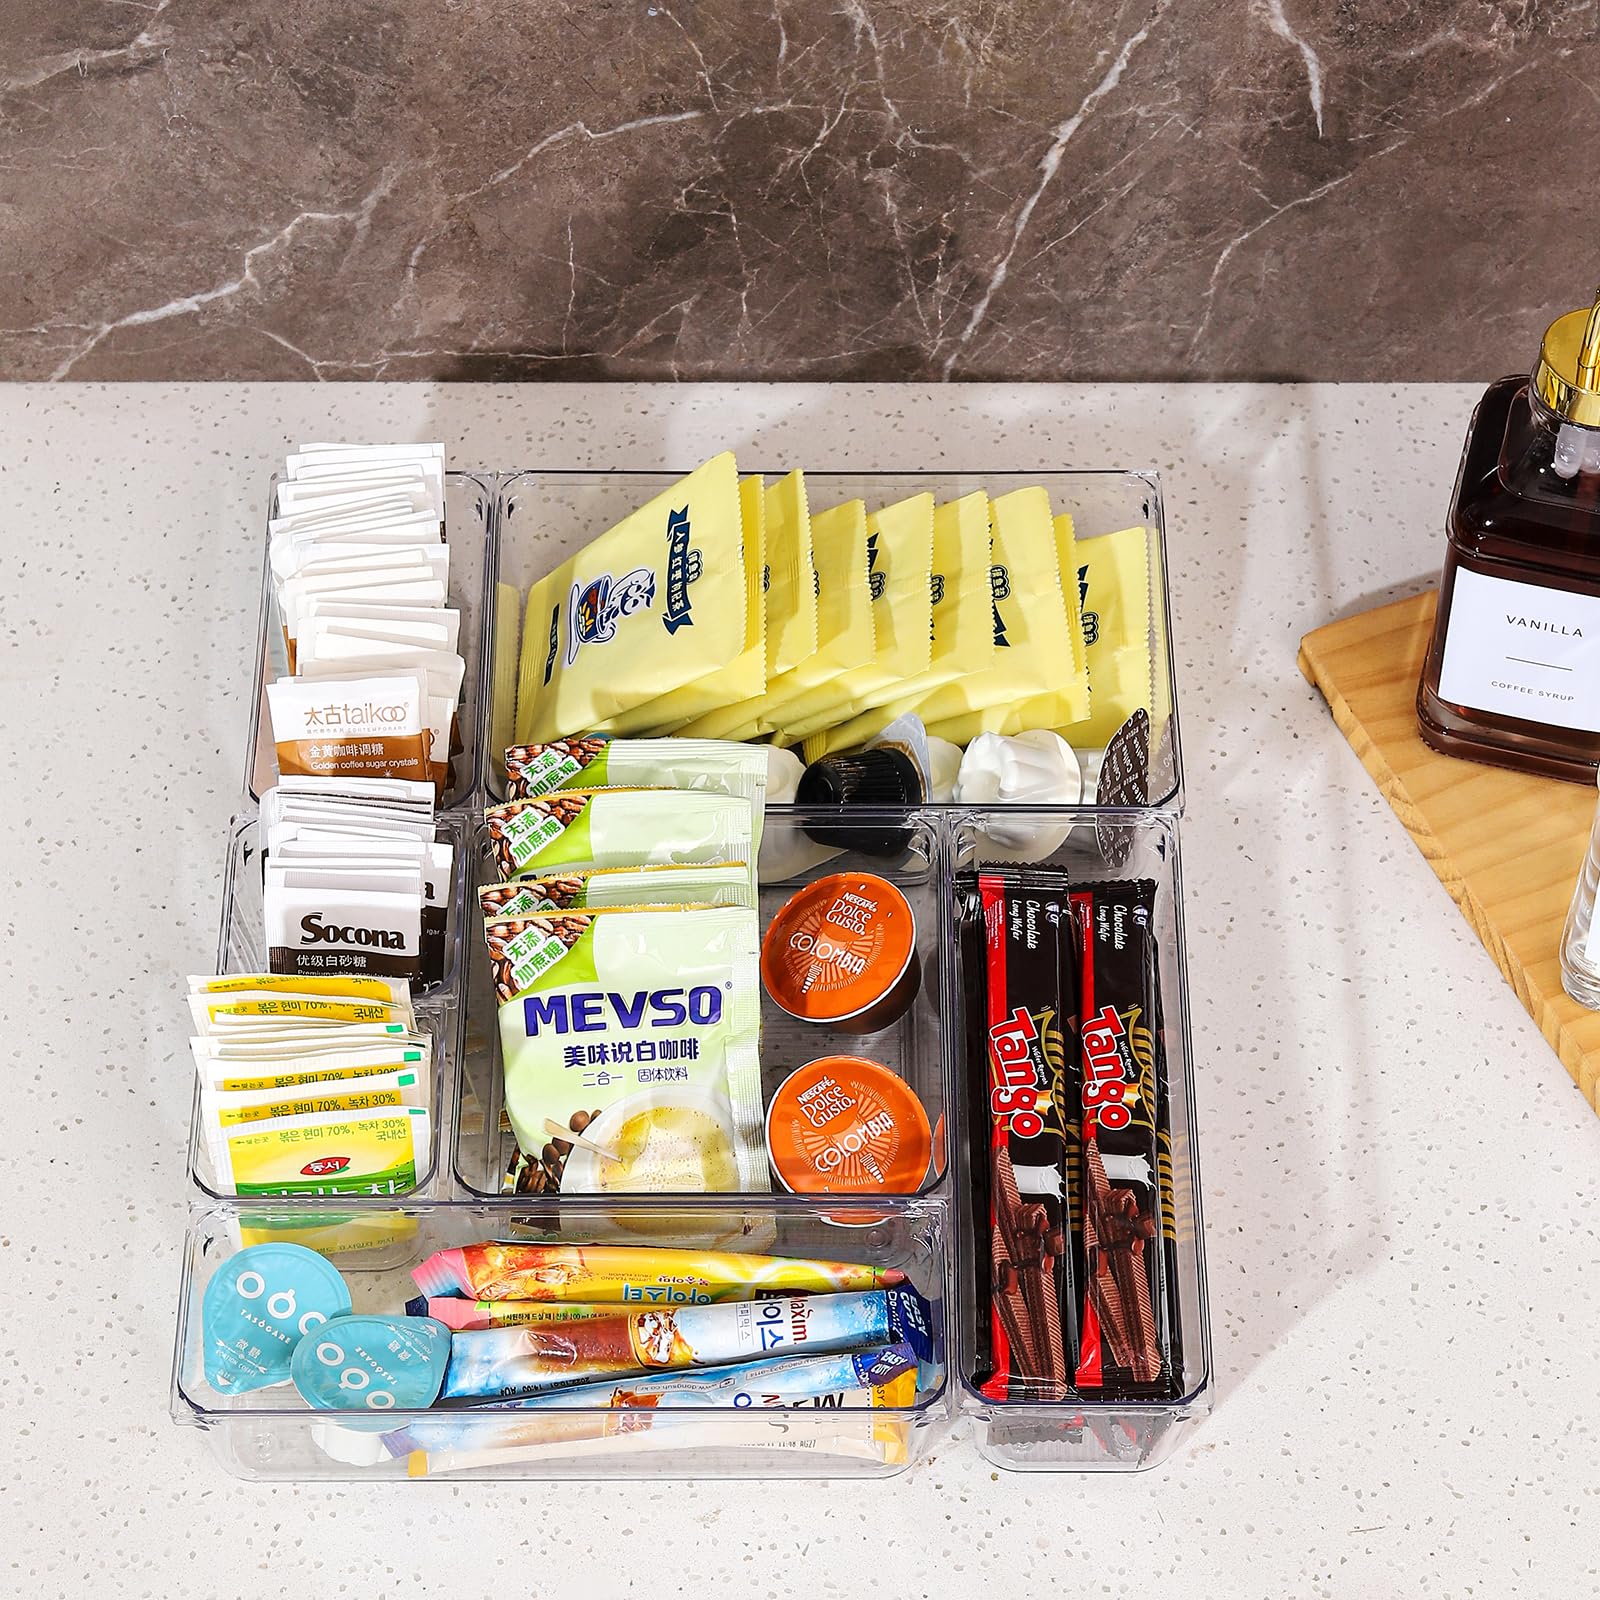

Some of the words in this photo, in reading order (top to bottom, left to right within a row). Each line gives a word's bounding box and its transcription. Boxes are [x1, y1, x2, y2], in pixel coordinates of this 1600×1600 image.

[1506, 615, 1583, 638] VANILLA
[1491, 680, 1534, 694] COFFEE
[1538, 690, 1575, 701] SYRUP
[310, 761, 340, 770] Golden
[340, 760, 365, 769] coffee
[365, 759, 388, 769] sugar
[389, 757, 419, 767] crystals
[831, 898, 872, 925] Dolce
[1009, 899, 1022, 918] Long
[1096, 905, 1110, 921] Long
[300, 912, 405, 950] Socona
[1010, 917, 1023, 941] Wafer
[1026, 899, 1041, 949] Chocolate
[1097, 921, 1110, 942] Wafer
[1113, 904, 1128, 950] Chocolate
[296, 955, 367, 968] 优级白砂糖
[790, 932, 865, 975] COLOMBIA
[353, 1008, 385, 1019] 국내산
[523, 985, 722, 1038] MEVSO
[563, 1038, 700, 1068] 美味说白咖啡
[582, 1071, 623, 1087] 二合一
[637, 1066, 688, 1083] 固体饮料
[989, 1006, 1044, 1139] Tango
[1081, 1005, 1131, 1130] Tango
[348, 1096, 369, 1108] 녹차
[372, 1093, 396, 1104] 30%
[801, 1084, 843, 1118] Dolce
[279, 1130, 300, 1143] 볶은
[303, 1126, 323, 1139] 현미
[327, 1123, 355, 1136] 70%,
[357, 1120, 379, 1132] 녹차
[382, 1118, 406, 1129] 30%
[375, 1128, 407, 1142] 국내산
[815, 1111, 894, 1172] COLOMBIA
[309, 1160, 340, 1172] 동서
[623, 1283, 712, 1304] 아이스티
[880, 1348, 908, 1366] EASY
